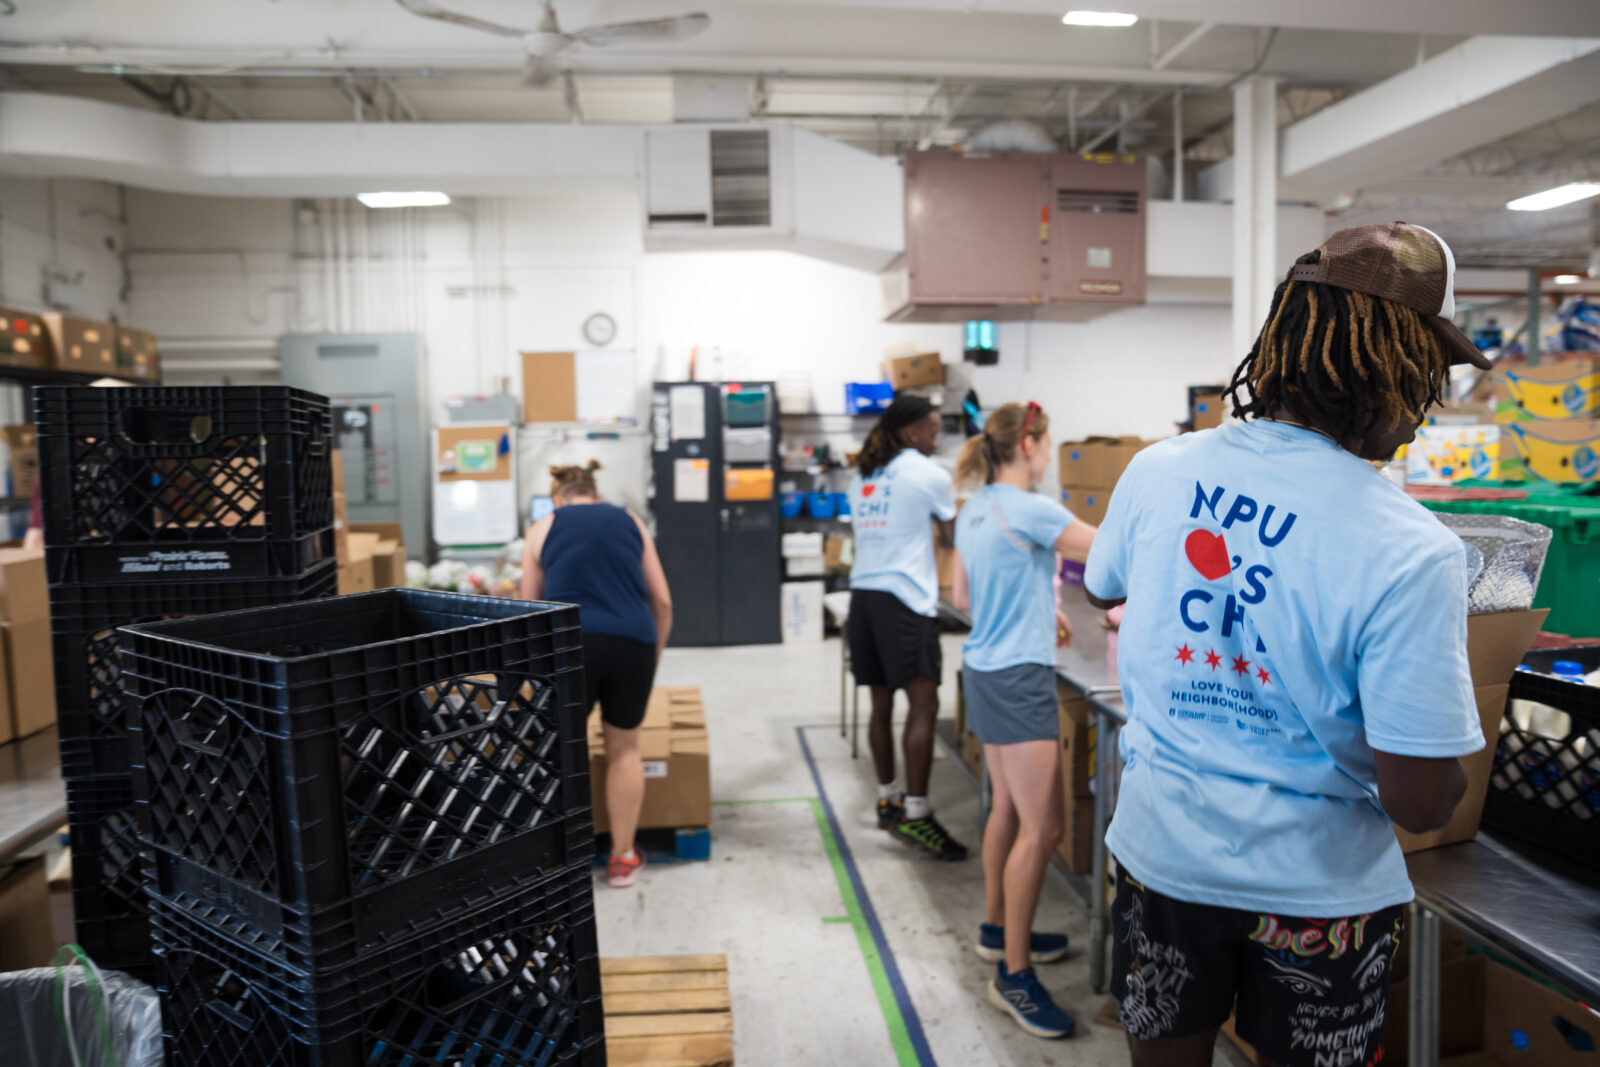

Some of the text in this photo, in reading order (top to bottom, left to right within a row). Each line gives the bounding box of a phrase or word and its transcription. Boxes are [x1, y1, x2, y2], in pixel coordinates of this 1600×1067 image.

[859, 501, 890, 517] CHI
[1189, 480, 1298, 548] NPU
[1191, 679, 1254, 702] LOVE YOUR
[1296, 1001, 1340, 1019] NEVER
[1313, 1036, 1370, 1067] NEW
